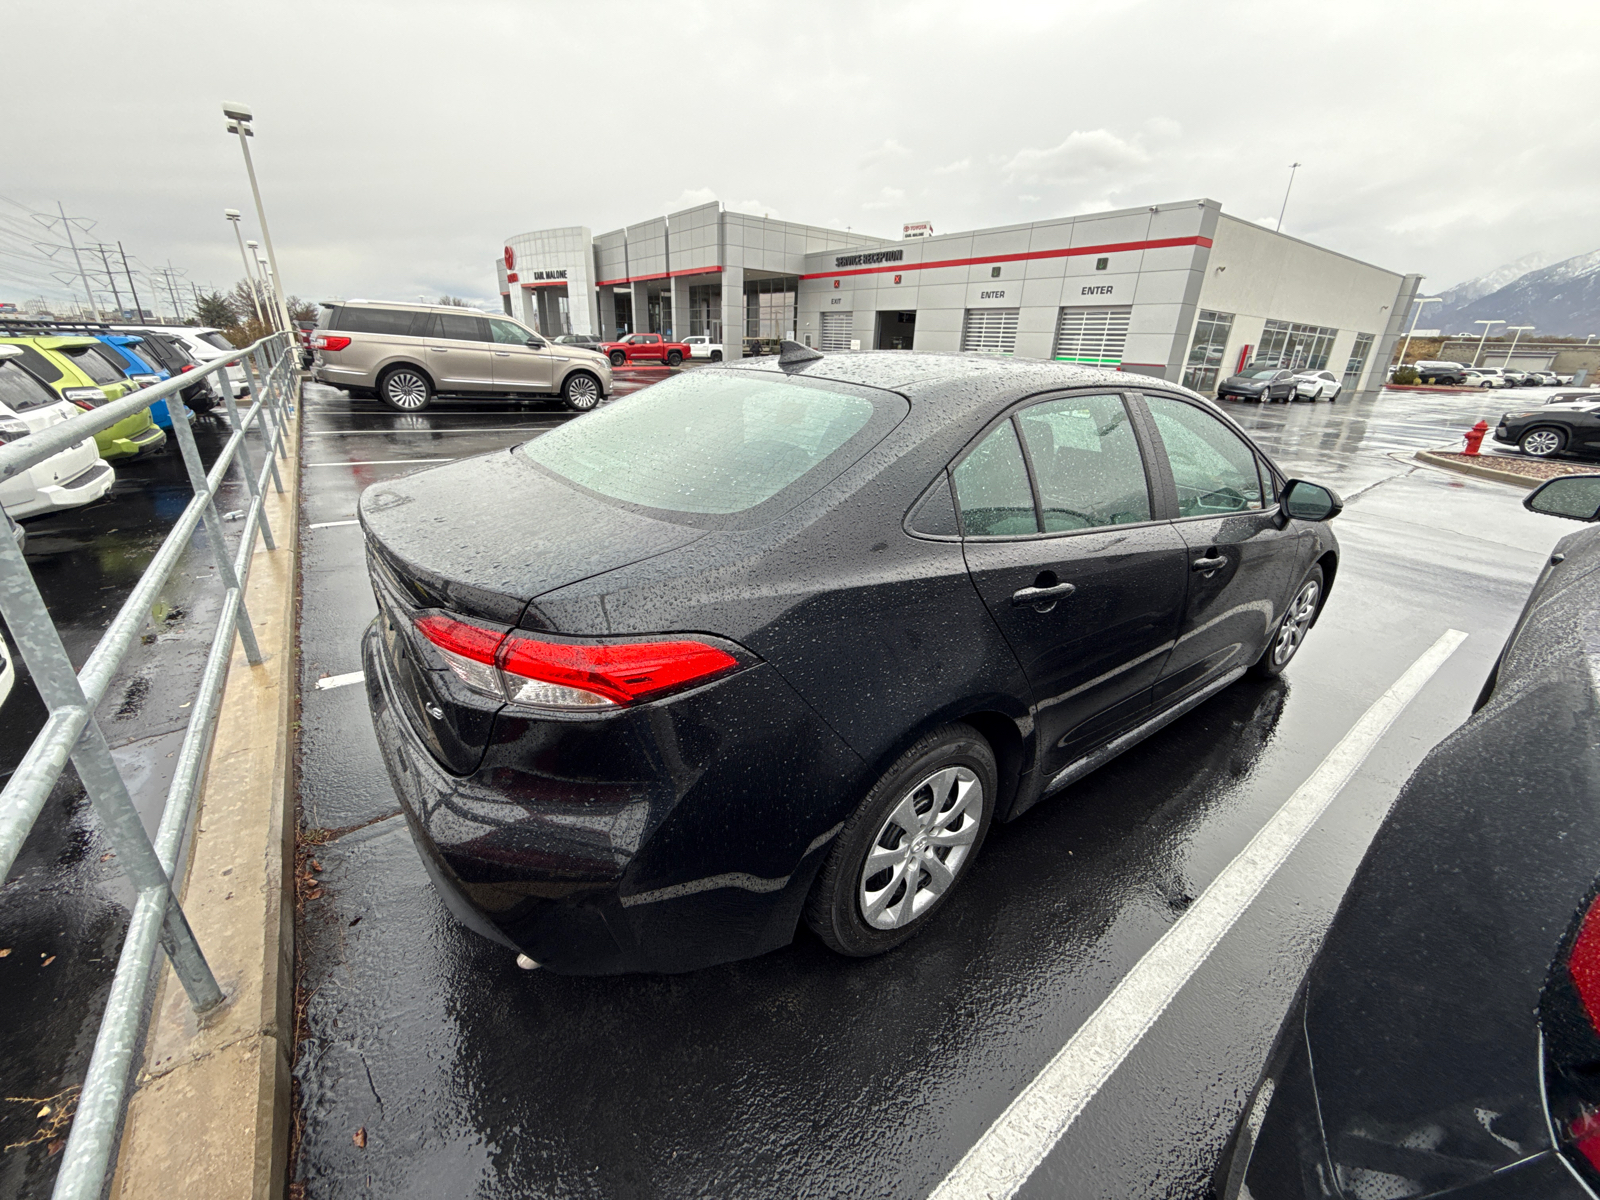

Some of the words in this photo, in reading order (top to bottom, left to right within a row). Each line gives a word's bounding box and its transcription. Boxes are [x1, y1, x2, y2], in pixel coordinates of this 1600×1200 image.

[835, 254, 862, 267] SERVICE
[863, 249, 903, 264] RECEPTION
[545, 270, 567, 279] MALONE
[980, 290, 1005, 299] ENTER
[1081, 285, 1113, 295] ENTER
